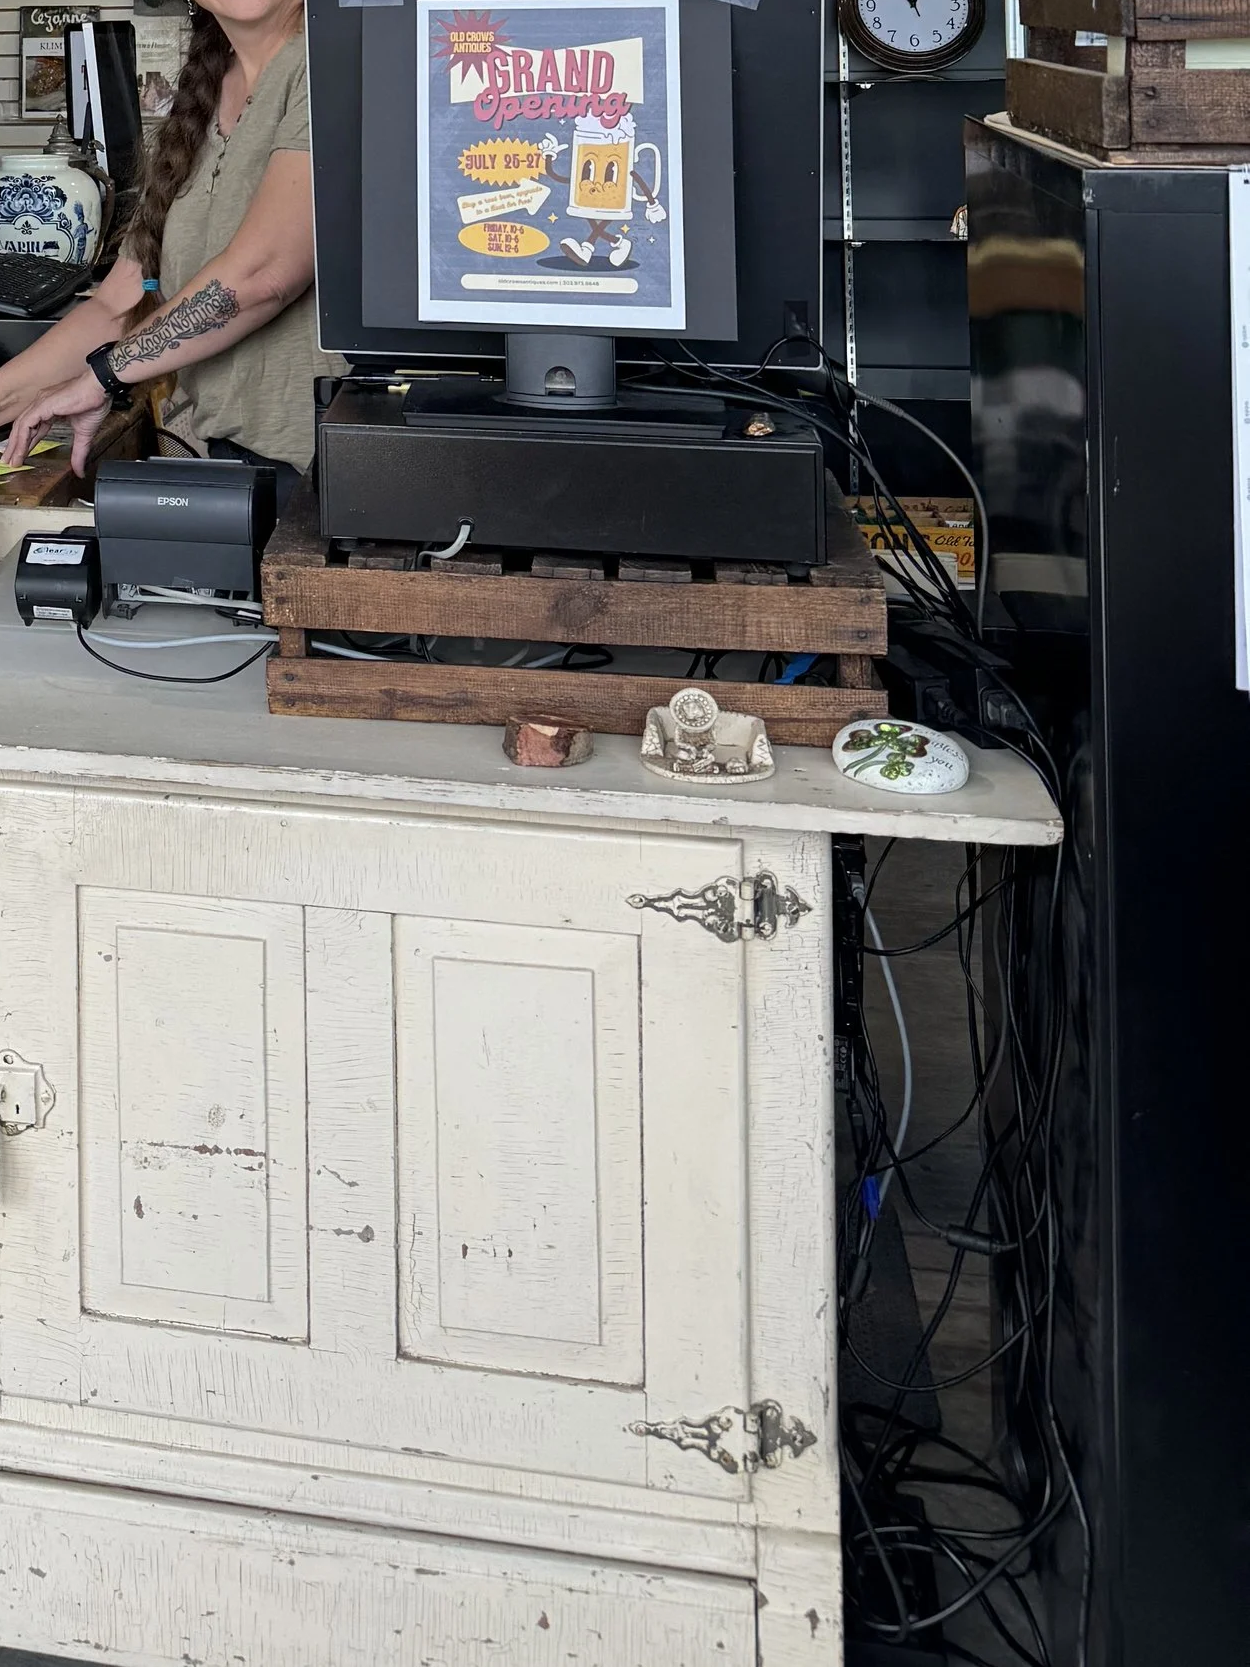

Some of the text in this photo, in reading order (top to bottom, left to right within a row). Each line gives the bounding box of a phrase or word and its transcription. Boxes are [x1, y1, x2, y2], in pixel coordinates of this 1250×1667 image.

[866, 0, 876, 12] 9
[30, 8, 88, 33] Cezanne
[872, 16, 882, 29] 8
[946, 17, 955, 29] 4
[450, 31, 495, 42] OLD CROWS
[887, 30, 897, 42] 7
[909, 34, 920, 47] 6
[932, 30, 942, 43] 5
[40, 42, 63, 50] KLIM
[453, 42, 492, 53] ANTIQUES
[486, 48, 615, 95] GRAND
[473, 87, 632, 131] Opening
[465, 154, 497, 170] JULY
[137, 322, 172, 353] Know
[172, 297, 224, 334] Nothing
[157, 496, 189, 507] EPSON
[934, 535, 958, 547] Old
[925, 755, 954, 771] you
